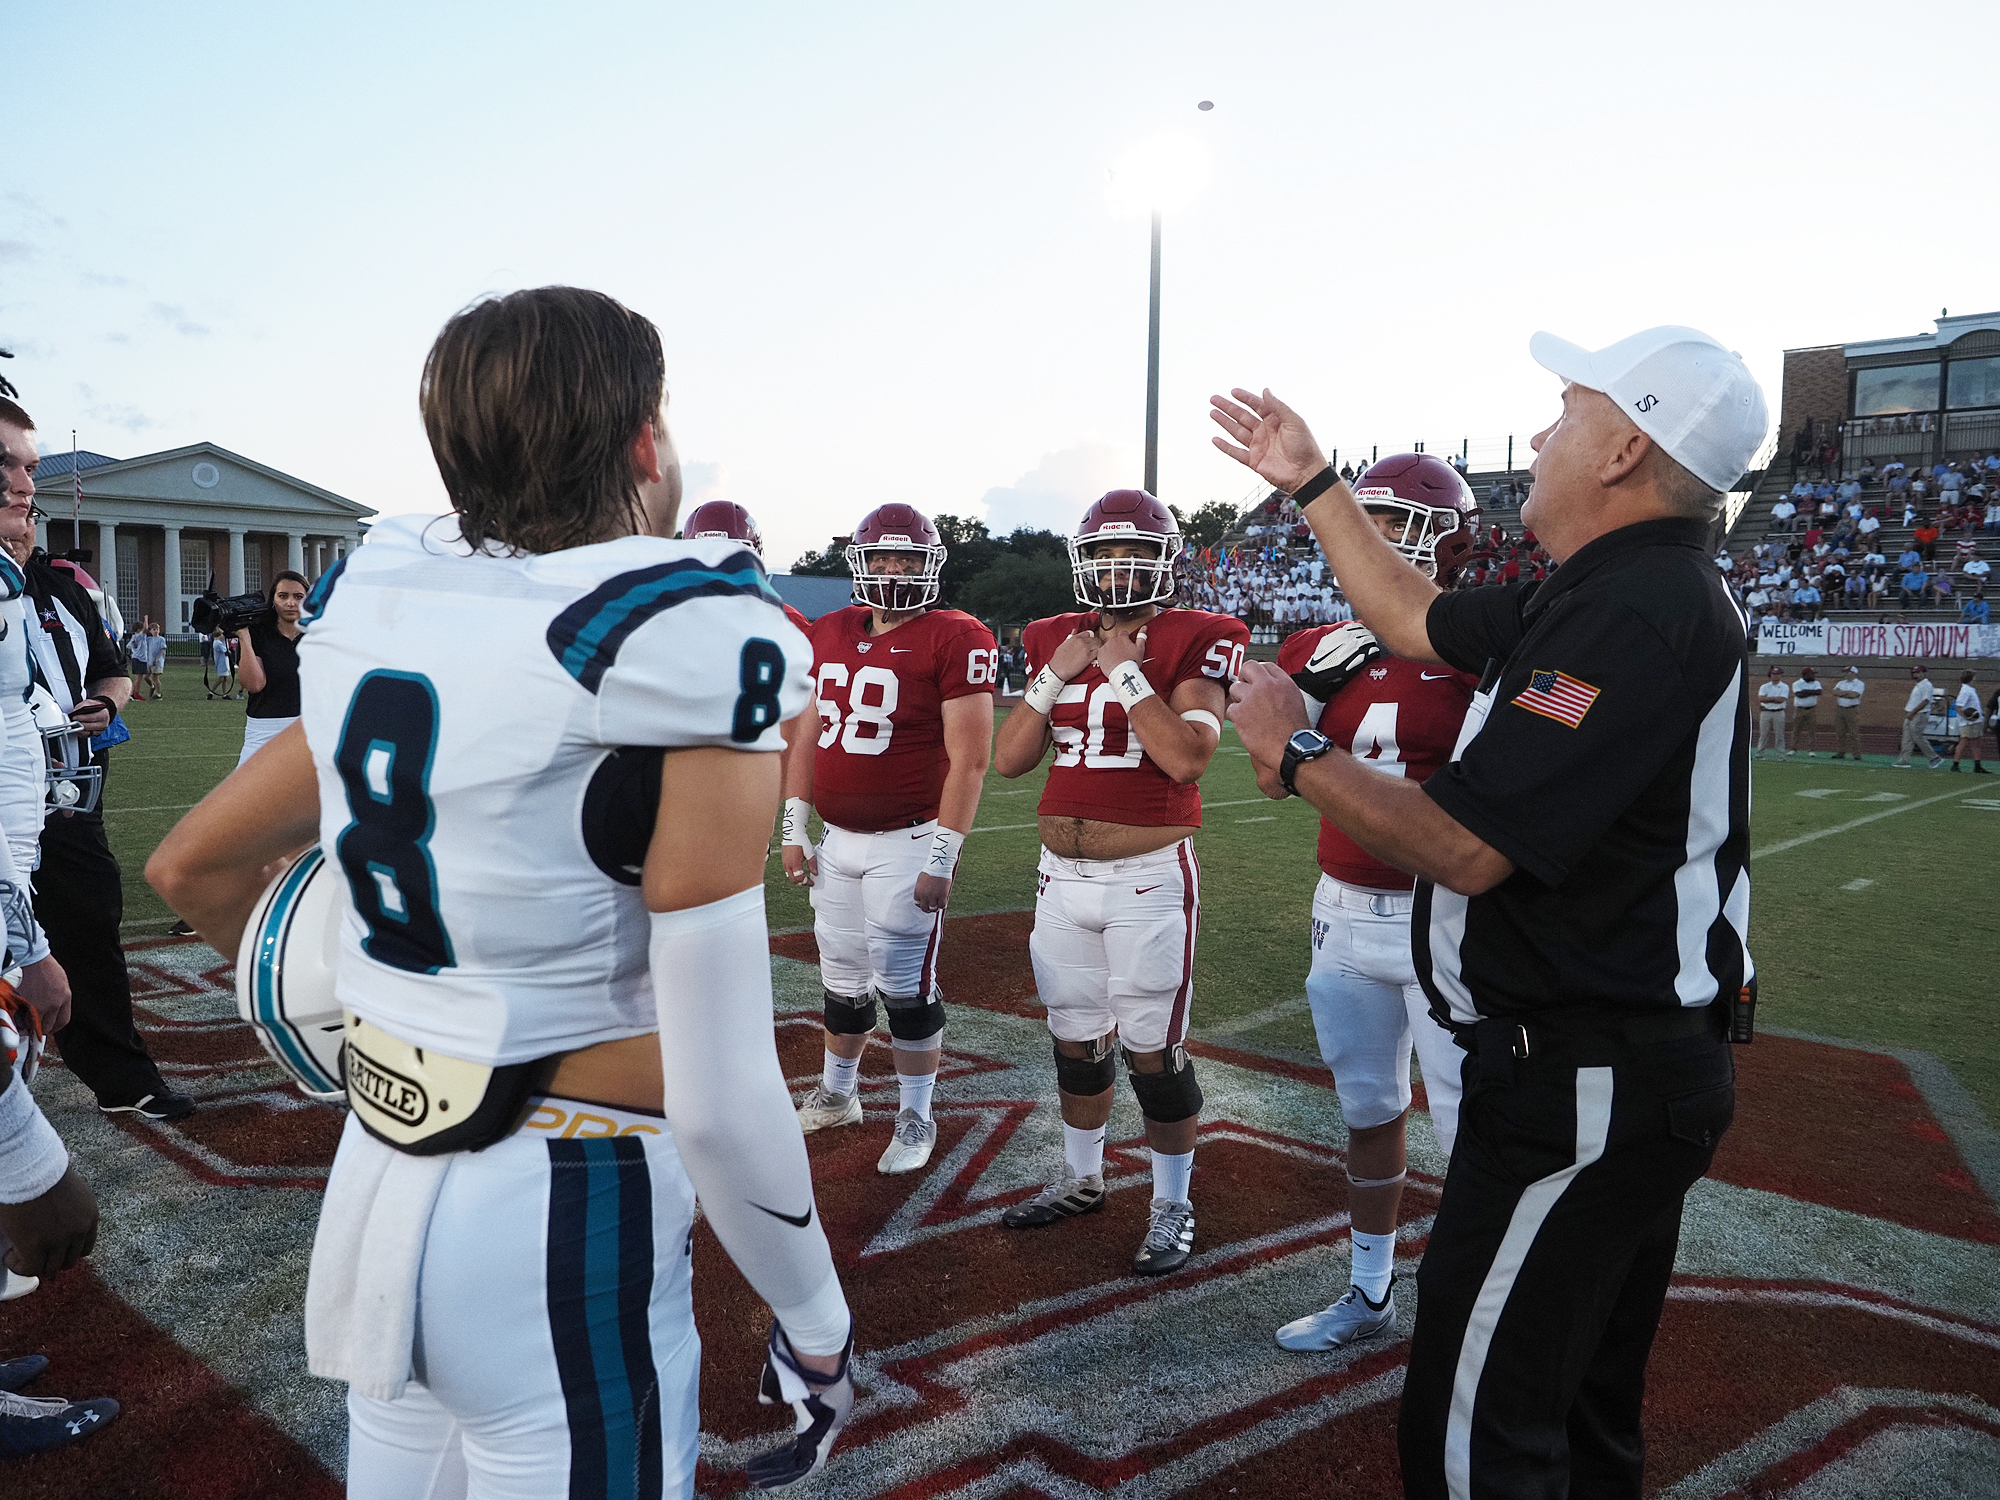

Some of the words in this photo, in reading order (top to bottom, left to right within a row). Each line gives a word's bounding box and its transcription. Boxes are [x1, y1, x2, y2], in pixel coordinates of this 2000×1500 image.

[1201, 639, 1245, 682] 50
[1762, 624, 1823, 638] WELCOME
[1776, 641, 1796, 654] TO
[1827, 626, 1887, 656] COOPER
[1894, 626, 1969, 658] STADIUM
[731, 637, 786, 743] 8
[966, 649, 998, 684] 68
[816, 663, 899, 755] 68
[1047, 683, 1143, 768] 50
[1352, 702, 1406, 778] 4
[334, 668, 457, 975] 8
